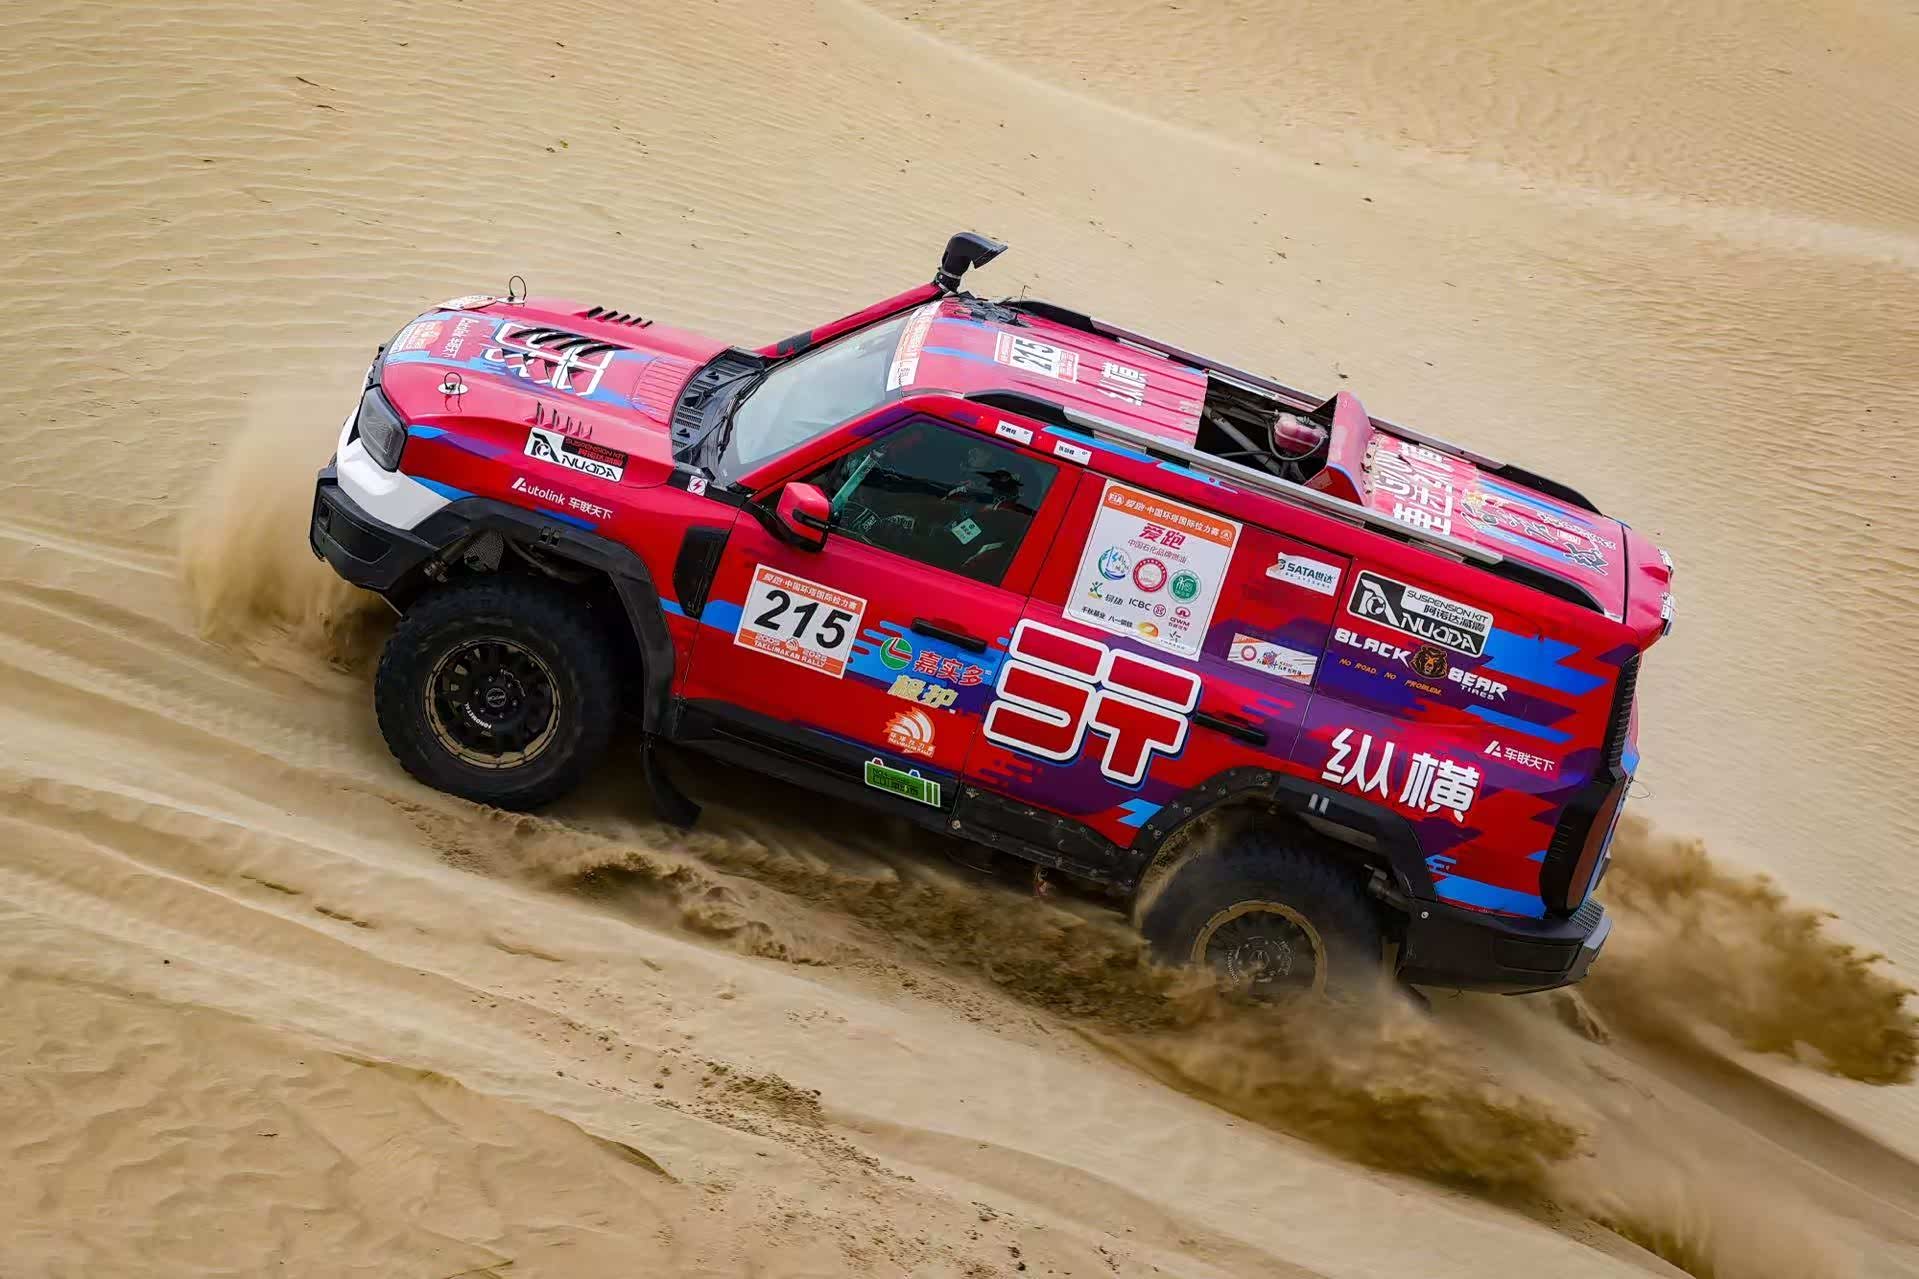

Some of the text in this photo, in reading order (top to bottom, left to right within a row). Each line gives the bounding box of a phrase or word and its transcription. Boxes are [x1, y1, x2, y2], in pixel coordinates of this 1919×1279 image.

[1012, 337, 1056, 374] 215
[511, 476, 614, 520] Autolink 车联天下
[1138, 522, 1187, 551] 爱跑
[754, 589, 853, 649] 215
[1128, 598, 1152, 612] ICBC
[1406, 589, 1490, 624] SUSPENSION KIT
[1423, 605, 1486, 632] 阿诺达减震
[754, 641, 826, 667] TAKLIMAKAN RALLY
[912, 649, 985, 687] 嘉实多
[1333, 627, 1413, 668] BLACK
[1447, 669, 1509, 701] BEAR
[1338, 657, 1352, 667] NO
[1383, 671, 1396, 681] NO
[1460, 684, 1494, 700] TIRES
[1321, 727, 1481, 823] 纵横
[1503, 747, 1555, 773] 车联天下
